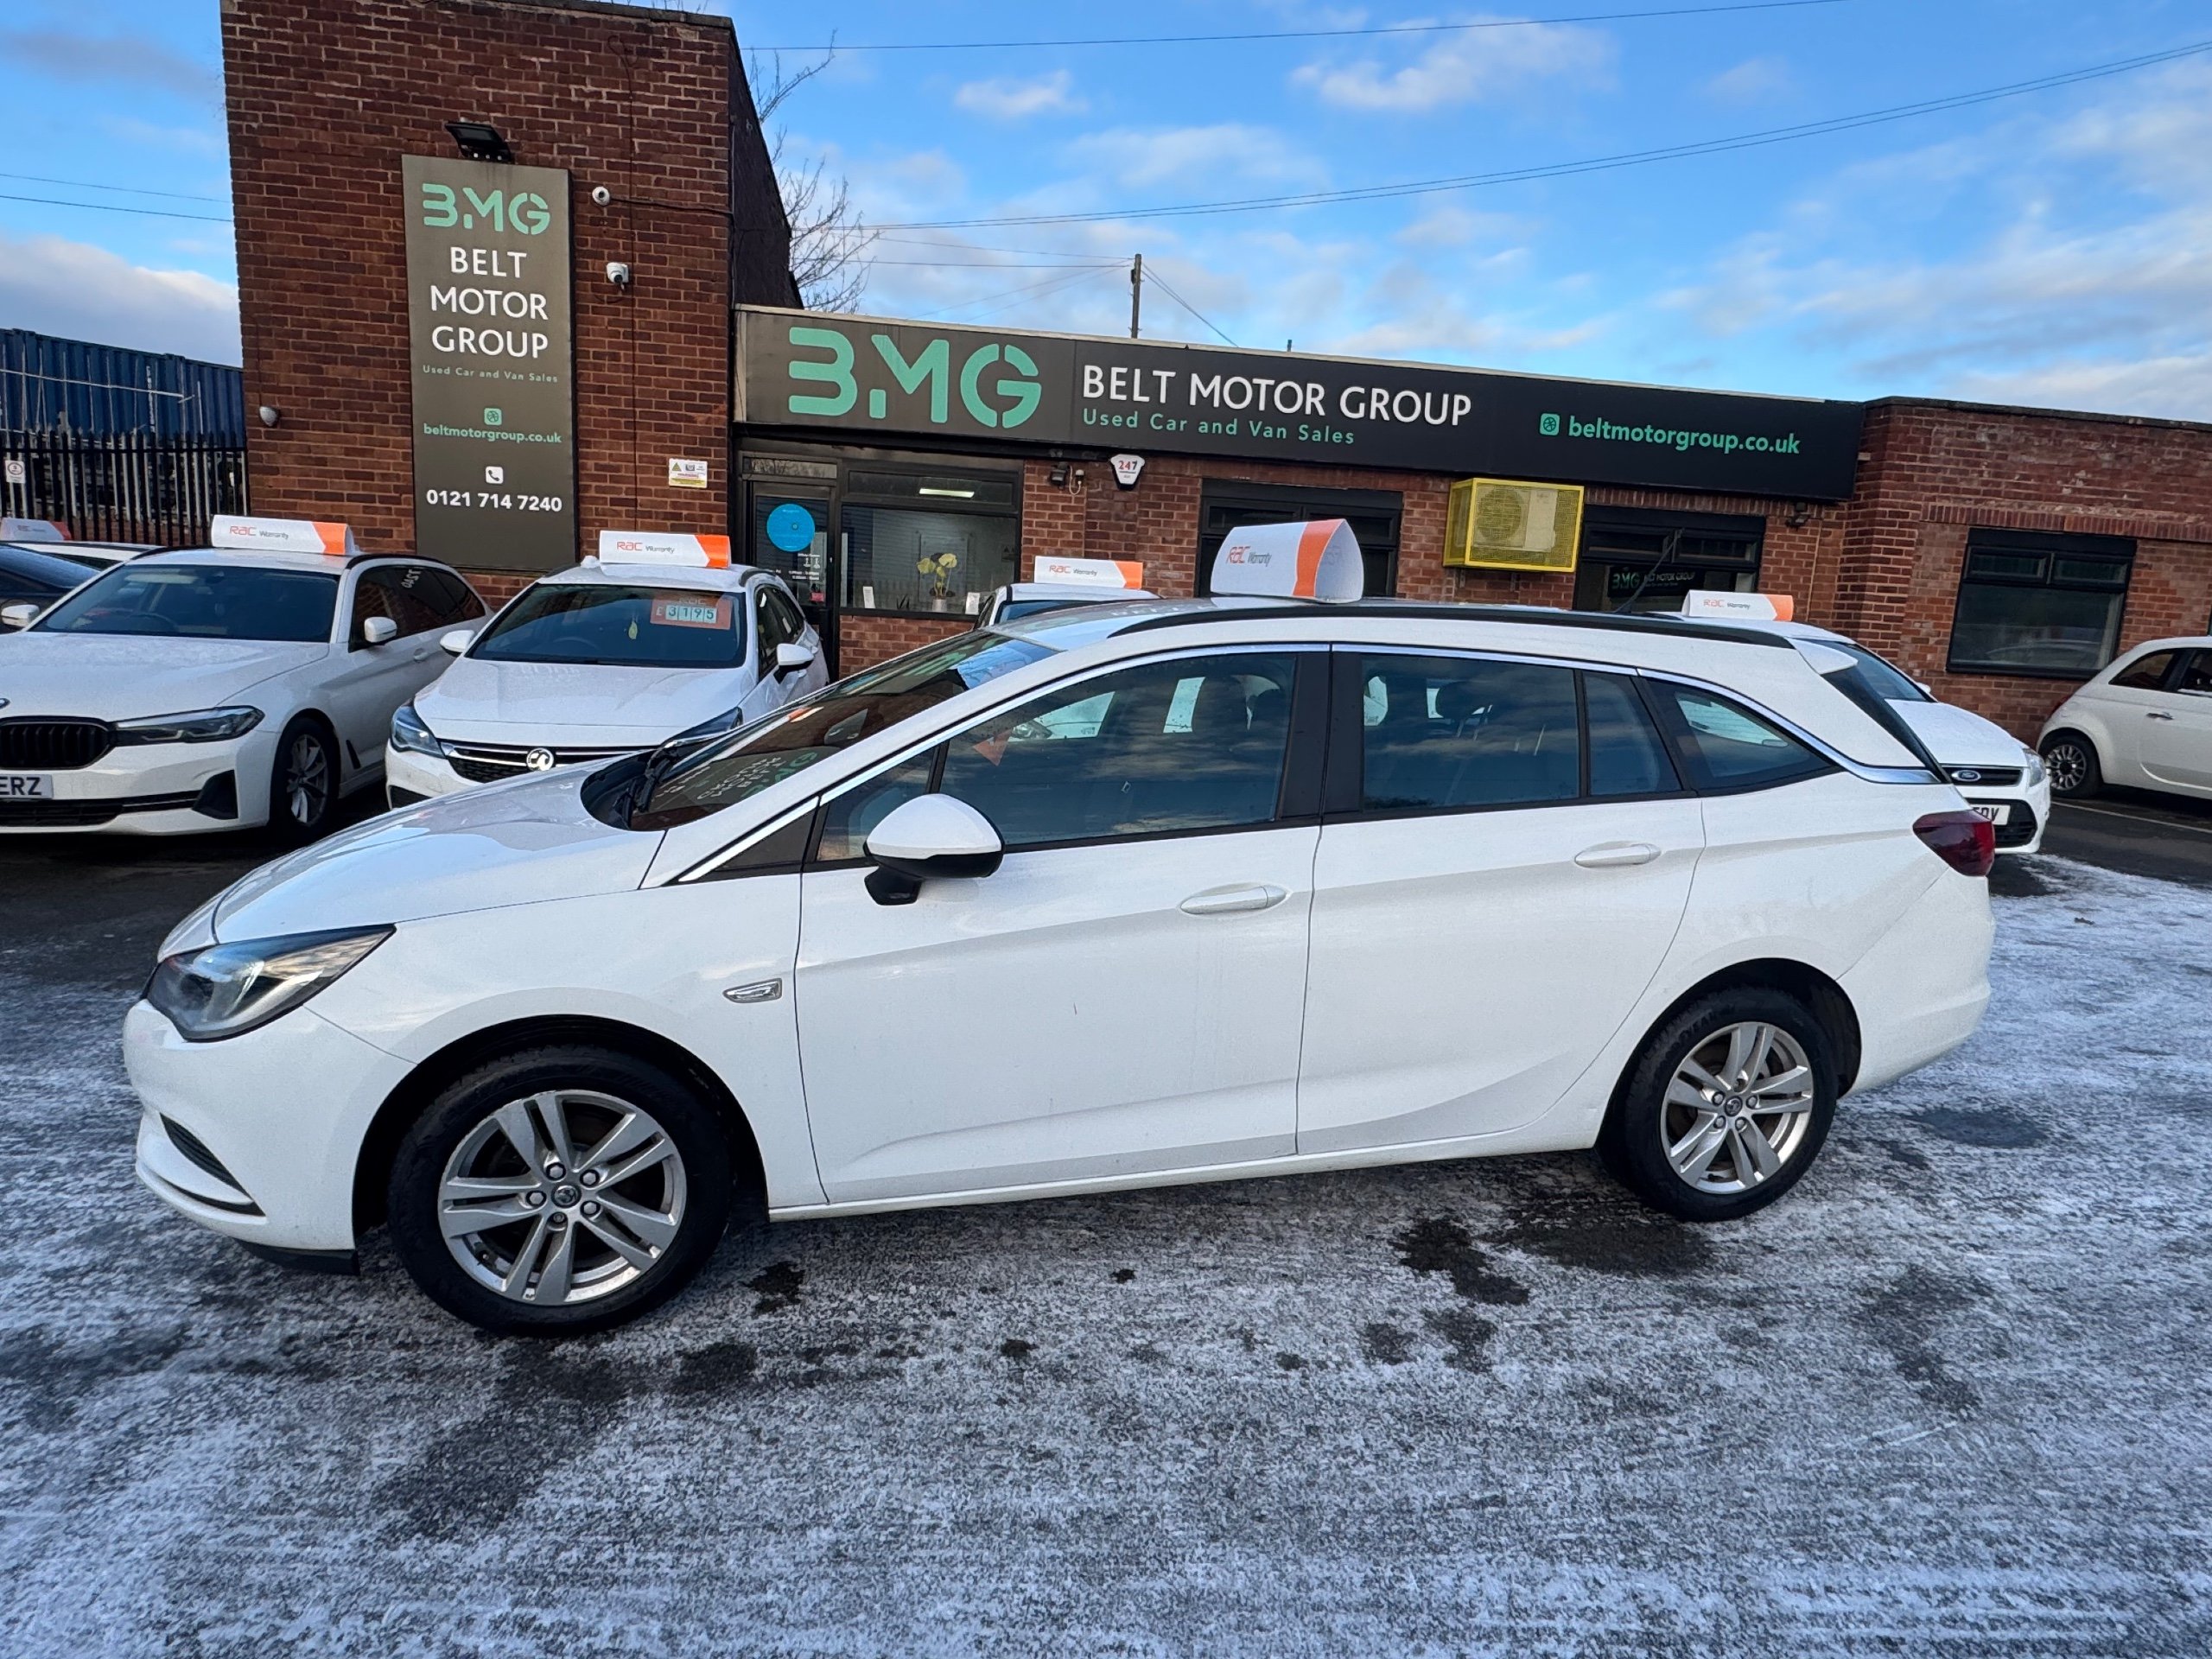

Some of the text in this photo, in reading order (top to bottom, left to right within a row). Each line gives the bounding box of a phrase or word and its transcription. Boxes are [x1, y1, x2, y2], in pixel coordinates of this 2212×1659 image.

[450, 246, 527, 278] BELT
[430, 285, 549, 320] MOTOR
[432, 325, 549, 359] GROUP
[423, 365, 558, 383] Used Car and Van Sales
[1084, 365, 1471, 426] BELT MOTOR GROUP
[423, 423, 562, 443] beltmotorgroup.co.uk
[1084, 408, 1354, 444] Used Car and Van Sales
[1568, 416, 1800, 454] beltmotorgroup.co.uk
[1118, 460, 1138, 470] 247
[426, 489, 562, 512] 0121 714 7240
[259, 531, 289, 540] Warranty
